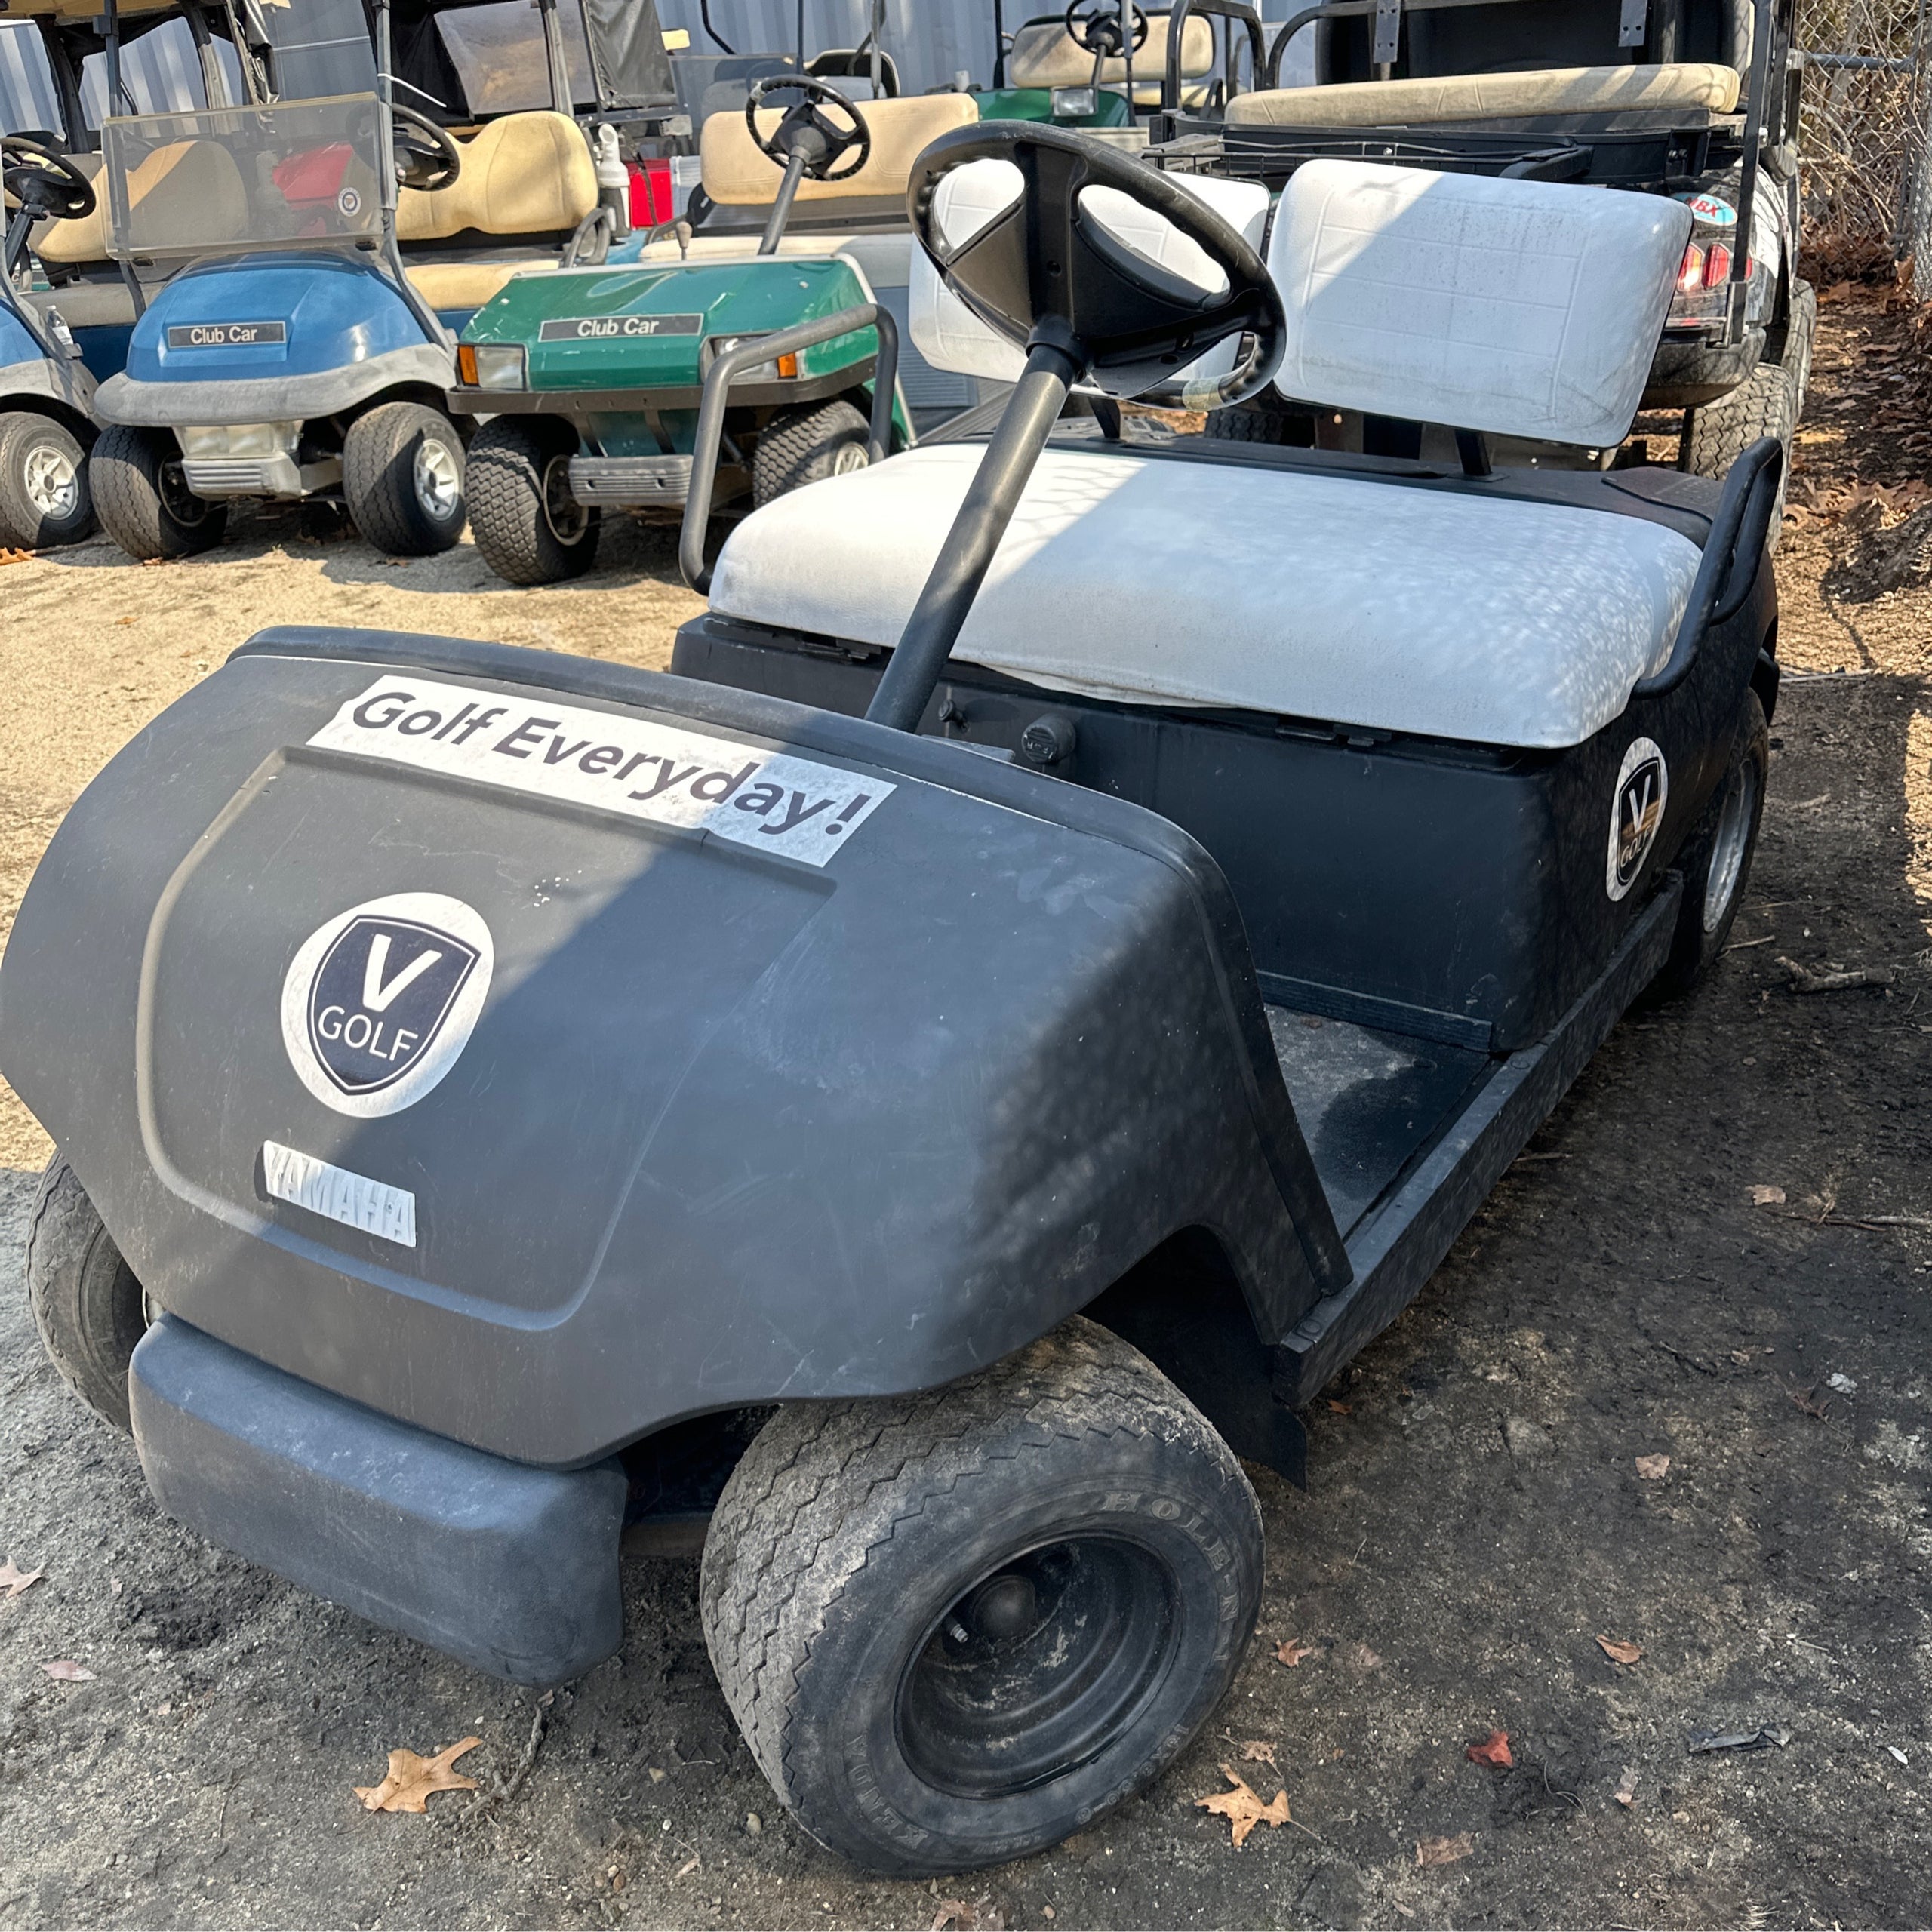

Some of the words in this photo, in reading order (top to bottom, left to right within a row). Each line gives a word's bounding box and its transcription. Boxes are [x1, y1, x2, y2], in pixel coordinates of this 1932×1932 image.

[191, 328, 225, 344] Club
[229, 326, 257, 342] Car
[577, 319, 619, 337] Club
[623, 318, 659, 334] Car
[352, 691, 509, 746] Golf
[491, 717, 872, 836] Everyday!
[1629, 774, 1651, 834] V
[1620, 825, 1652, 868] GOLF
[362, 933, 443, 1012] V
[318, 1005, 418, 1062] GOLF
[265, 1142, 415, 1247] YAMAHA
